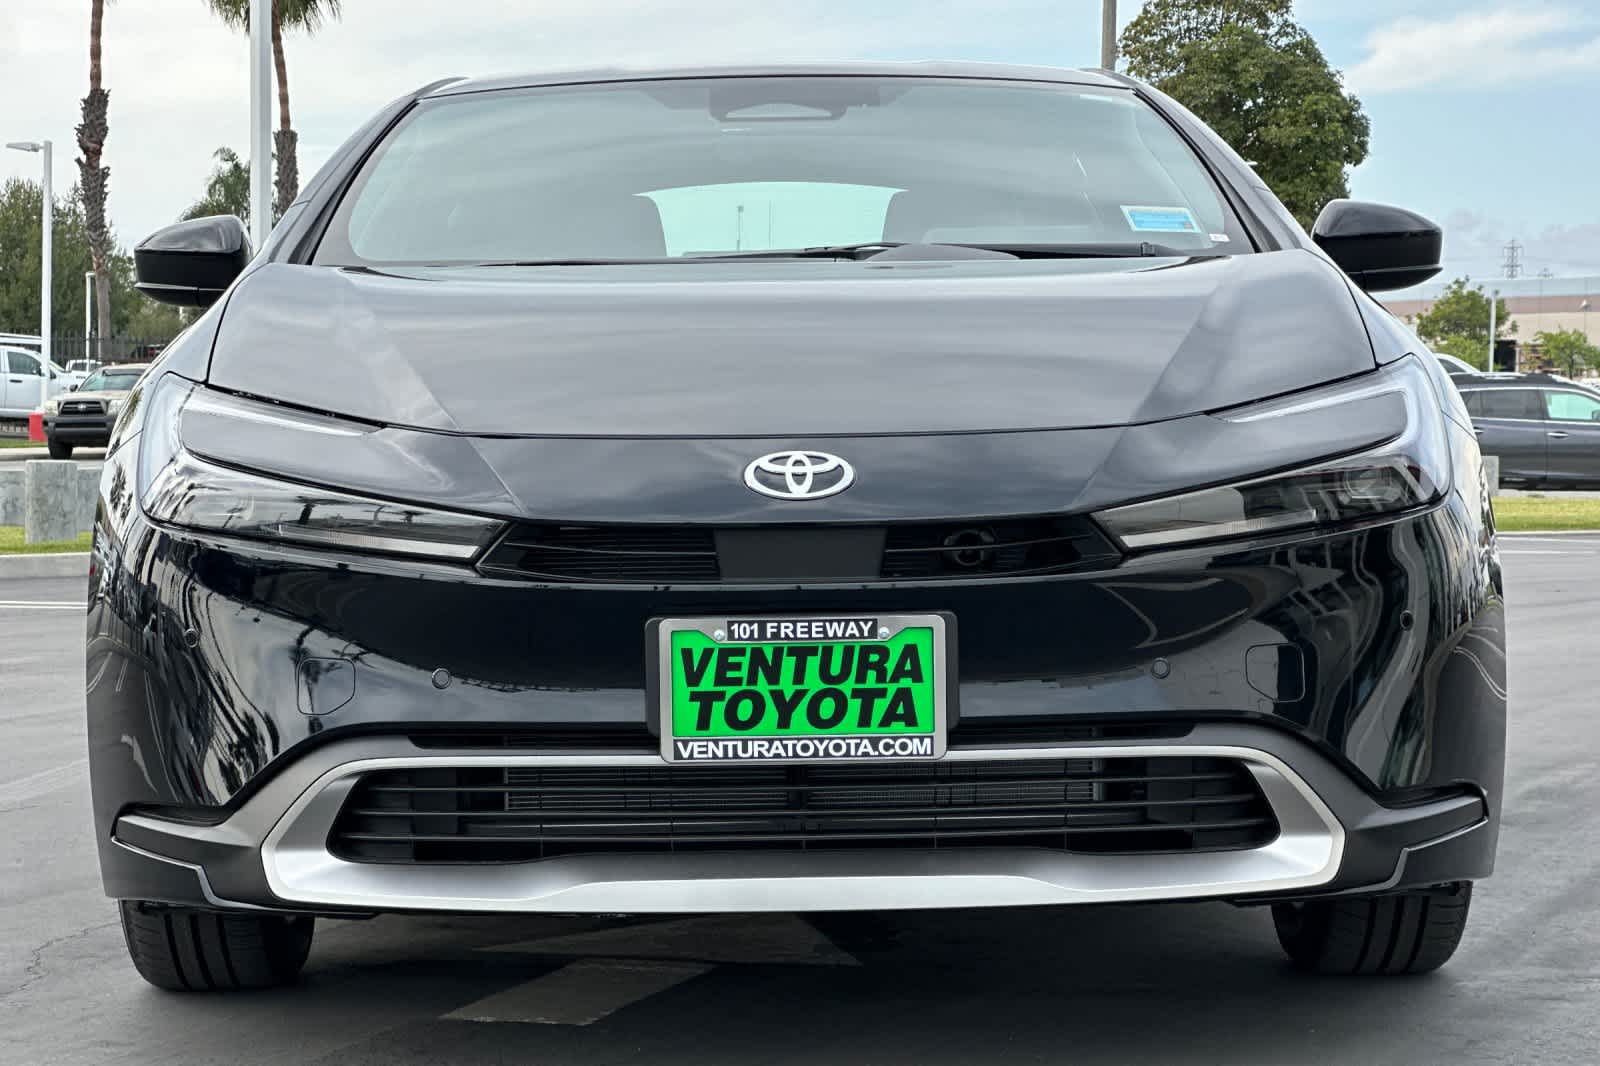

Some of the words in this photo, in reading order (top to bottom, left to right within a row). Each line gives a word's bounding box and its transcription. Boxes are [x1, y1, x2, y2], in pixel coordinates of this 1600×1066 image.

[730, 622, 760, 639] 101
[766, 620, 874, 638] FREEWAY
[680, 644, 924, 687] VENTURA
[689, 687, 919, 731] TOYOTA
[677, 737, 932, 759] VENTURATOYOTA.COM
